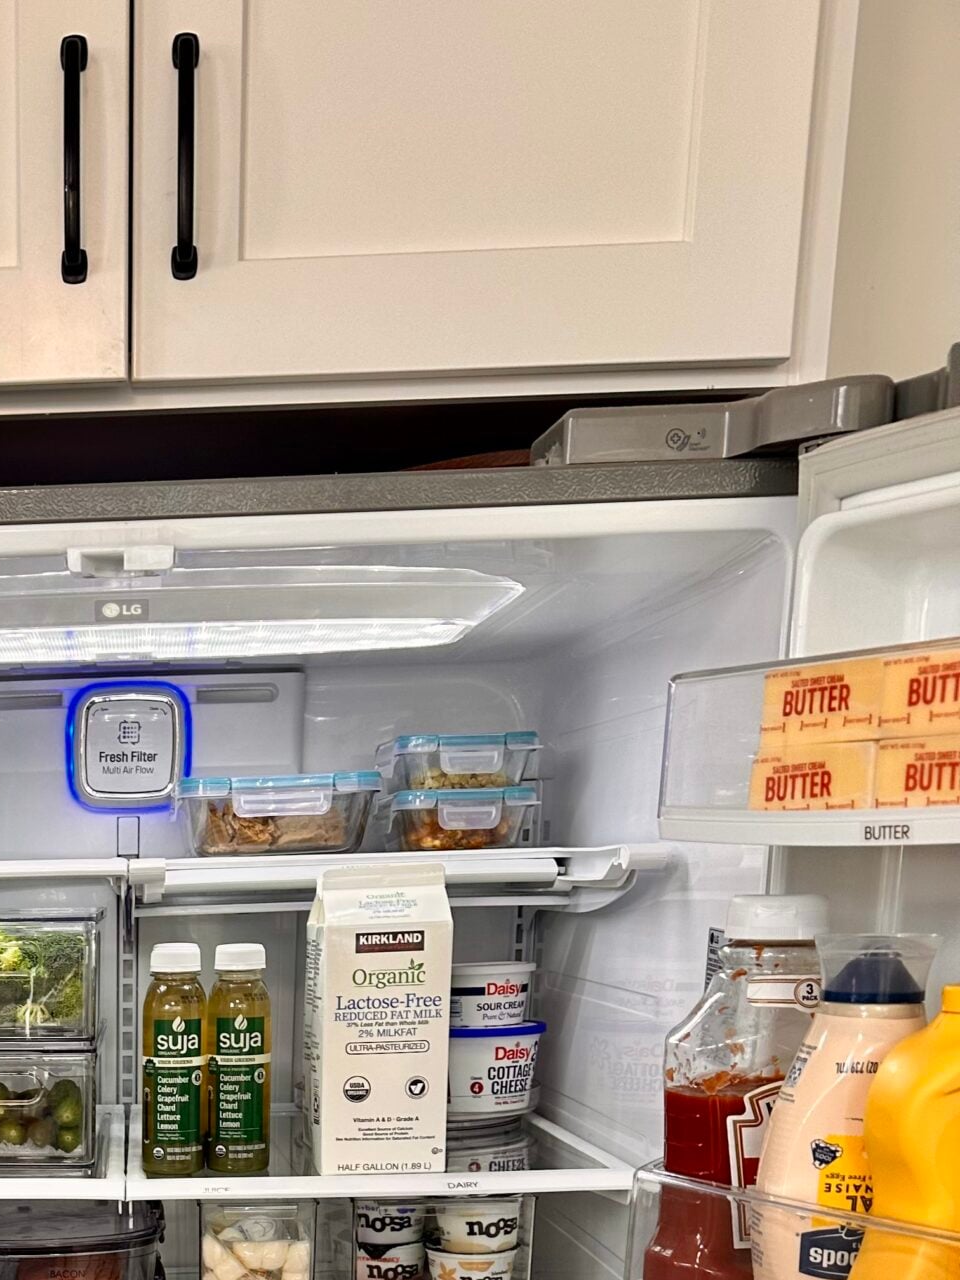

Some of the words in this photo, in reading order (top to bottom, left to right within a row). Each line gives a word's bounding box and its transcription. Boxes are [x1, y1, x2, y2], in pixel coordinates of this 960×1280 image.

[122, 604, 142, 615] LG
[906, 673, 960, 707] BUTT
[782, 684, 851, 717] BUTTER
[99, 751, 129, 763] Fresh
[130, 751, 158, 762] Filter
[102, 766, 121, 774] Multi
[122, 766, 133, 774] Air
[135, 765, 154, 774] Flow
[905, 761, 960, 792] BUTT
[765, 770, 832, 802] BUTTER
[864, 825, 910, 840] BUTTER
[359, 933, 422, 945] KIRKLAND
[352, 967, 426, 989] Organic
[487, 983, 521, 997] Daisy
[806, 983, 814, 995] 3
[336, 993, 442, 1011] Lactose-Free
[477, 1003, 502, 1011] SOUR
[334, 1011, 387, 1022] REDUCED
[391, 1010, 411, 1021] FAT
[413, 1008, 443, 1019] MILK
[358, 1030, 374, 1038] 2%
[377, 1028, 418, 1037] MILKFAT
[157, 1034, 199, 1055] suja
[219, 1031, 262, 1053] suja
[349, 1043, 427, 1052] ULTRA-PASTEURIZED
[495, 1046, 531, 1061] Daisy
[488, 1063, 532, 1080] COTTAGE
[157, 1076, 189, 1084] Cucumber
[157, 1086, 177, 1094] Celery
[219, 1083, 239, 1092] Celery
[491, 1078, 528, 1095] CHEESE
[157, 1095, 189, 1103] Grapefruit
[219, 1092, 252, 1101] Grapefruit
[157, 1113, 181, 1121] Lettuce
[219, 1120, 240, 1128] Lemon
[362, 1163, 399, 1171] GALLON
[401, 1162, 421, 1170] (1.89
[424, 1162, 431, 1170] L)
[50, 1270, 85, 1279] BACON
